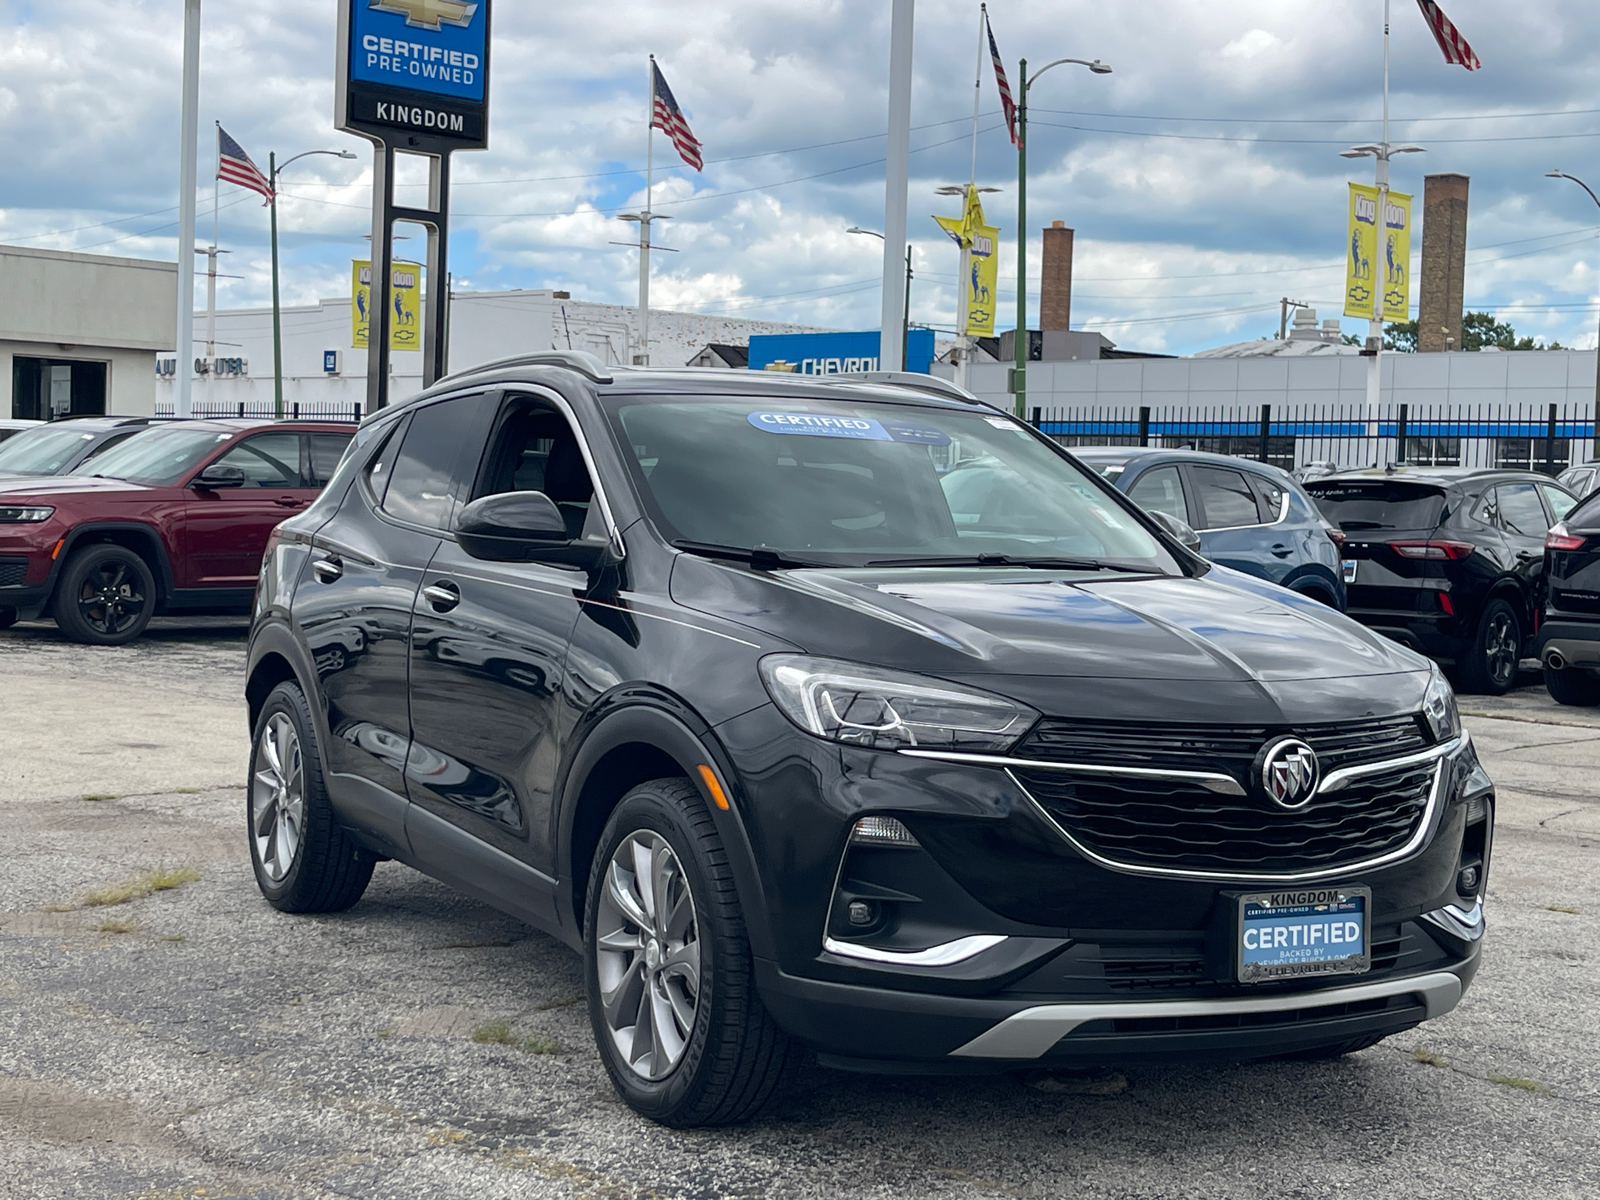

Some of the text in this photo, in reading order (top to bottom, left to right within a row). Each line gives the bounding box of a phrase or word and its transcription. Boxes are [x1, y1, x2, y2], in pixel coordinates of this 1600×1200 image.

[362, 34, 479, 70] CERTIFIED
[367, 53, 474, 85] PRE-OWNED
[376, 101, 464, 132] KINGDOM
[1354, 192, 1376, 225] King
[1385, 200, 1406, 228] dom
[393, 269, 415, 287] dom
[759, 413, 872, 431] CERTIFIED
[1270, 890, 1339, 906] KINGDOM
[1247, 906, 1309, 916] CERTIFIED PRE-OWNED
[1243, 921, 1360, 950] CERTIFIED
[1280, 947, 1325, 958] BACKED BY
[1268, 962, 1338, 977] CHEVROLET
